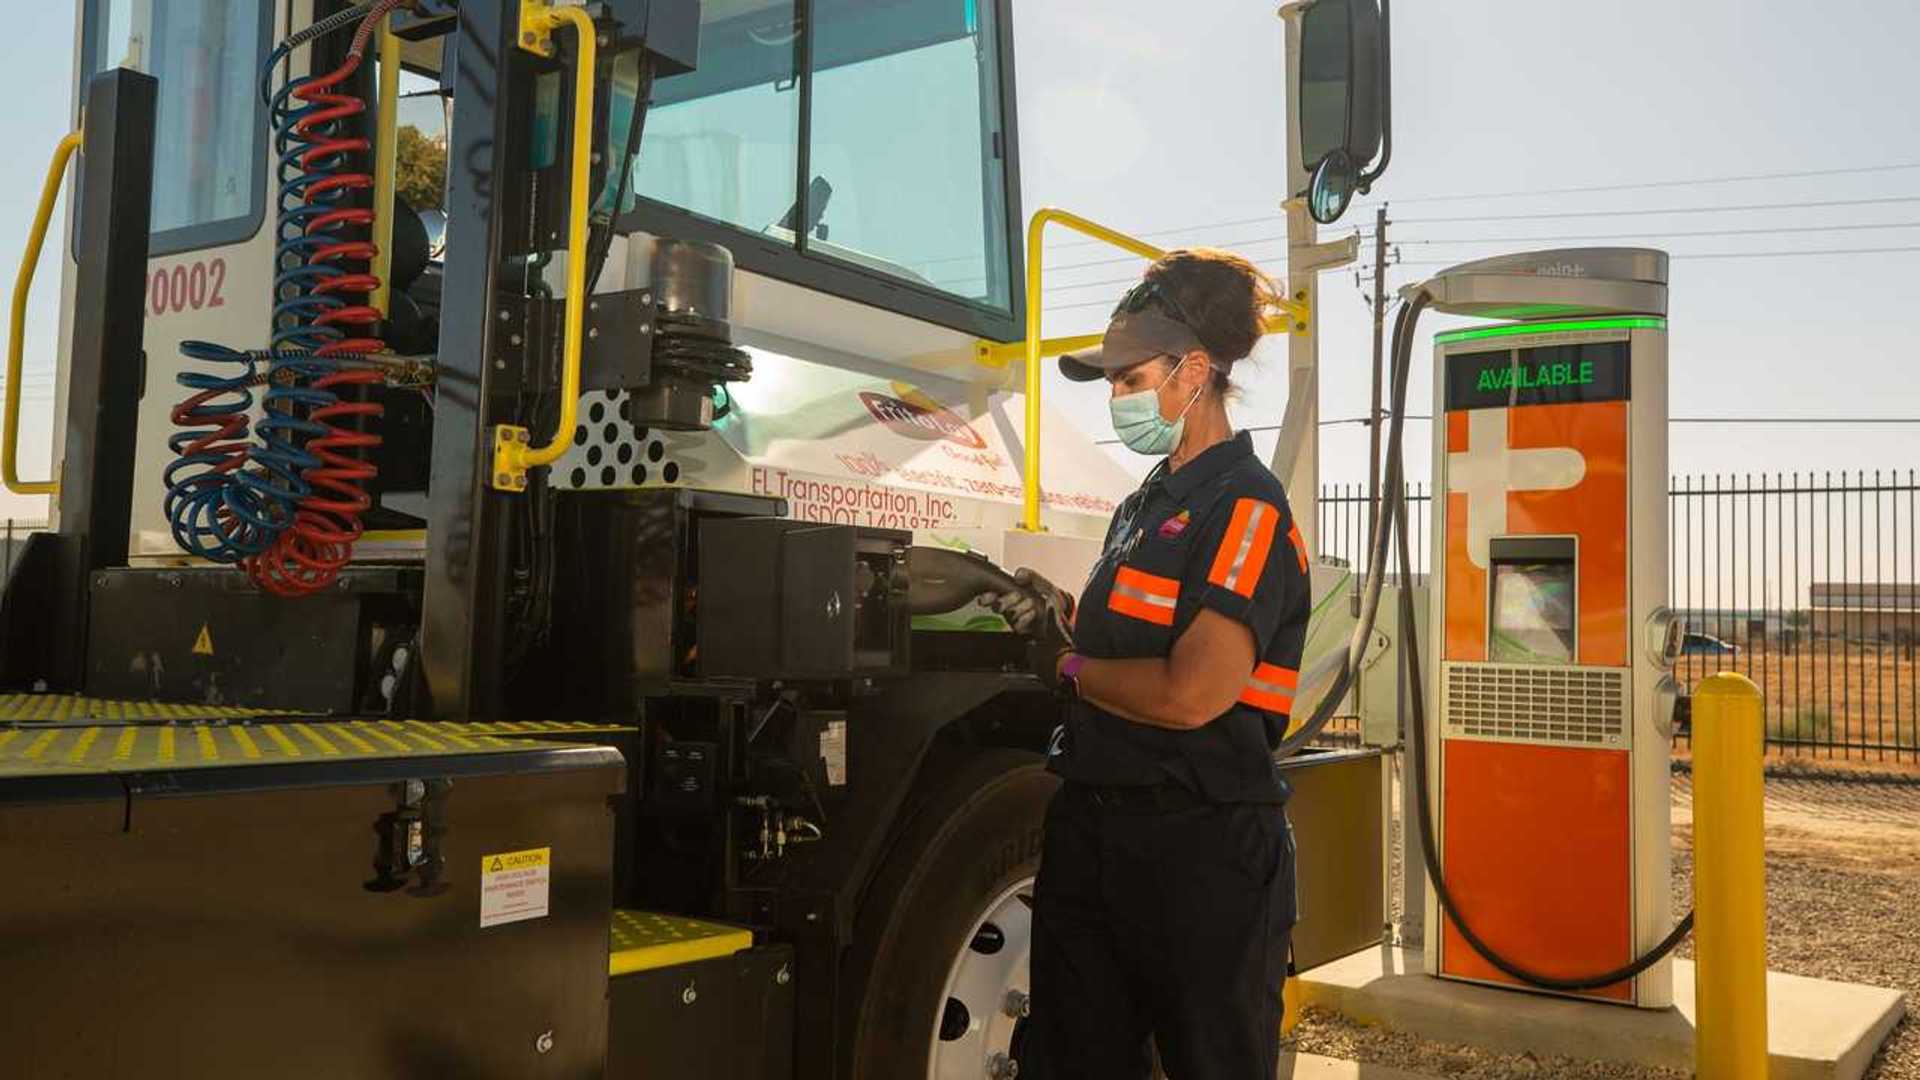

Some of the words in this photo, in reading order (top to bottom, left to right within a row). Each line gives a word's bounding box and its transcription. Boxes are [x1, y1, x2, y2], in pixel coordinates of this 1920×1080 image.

[146, 258, 226, 316] 0002
[1477, 361, 1594, 391] AVAILABLE
[752, 467, 772, 495] FL
[777, 471, 921, 517] Transportation,
[926, 493, 957, 519] Inc.
[793, 502, 860, 525] USDOT
[506, 854, 543, 865] CAUTION
